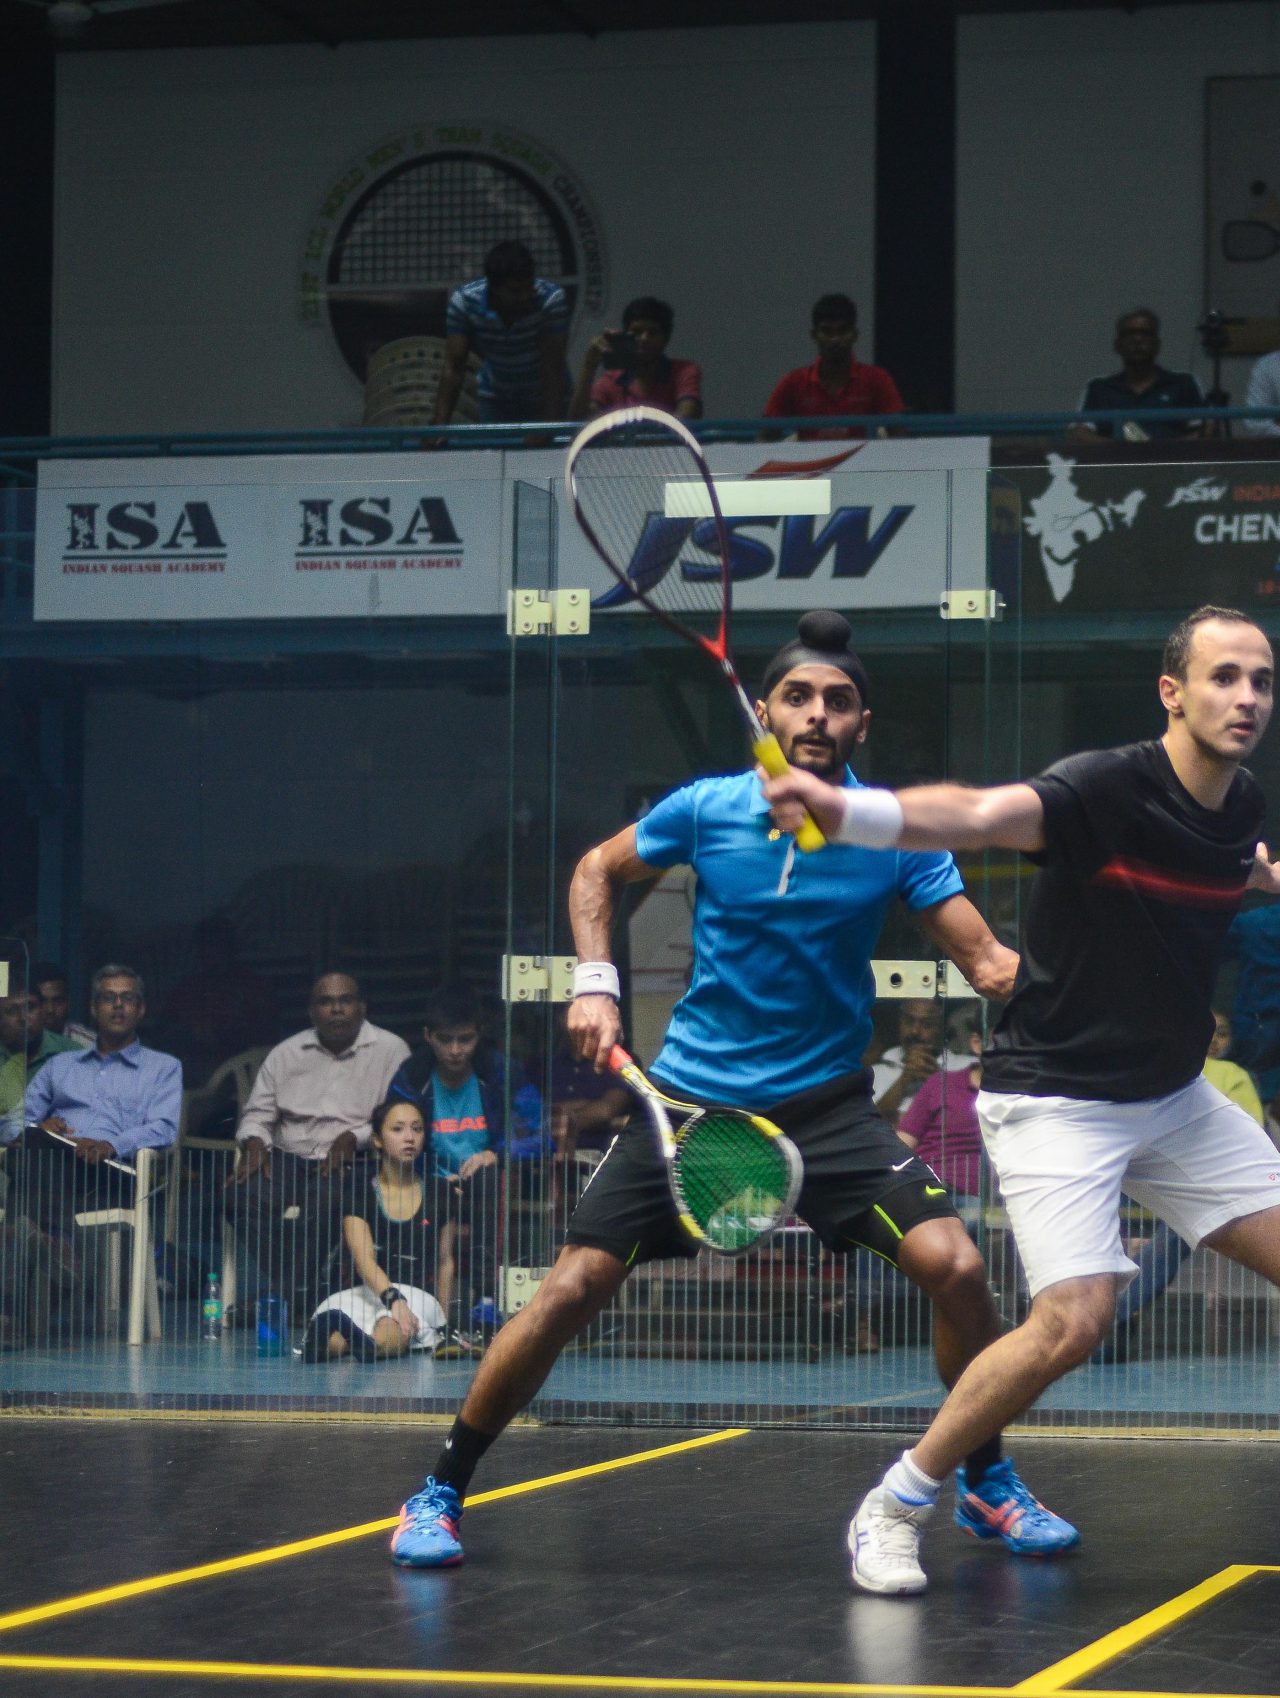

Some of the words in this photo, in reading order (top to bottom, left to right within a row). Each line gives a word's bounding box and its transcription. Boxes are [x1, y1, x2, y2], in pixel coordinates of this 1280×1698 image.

[1165, 484, 1228, 508] JSW
[66, 500, 227, 551] ISA
[298, 496, 463, 548] ISA
[62, 563, 108, 575] INDIAN
[111, 562, 162, 574] SQUASH
[166, 562, 226, 573] ACADEMY
[295, 560, 342, 571] INDIAN
[345, 559, 397, 571] SQUASH
[401, 558, 462, 570] ACADEMY
[590, 504, 916, 609] JSW
